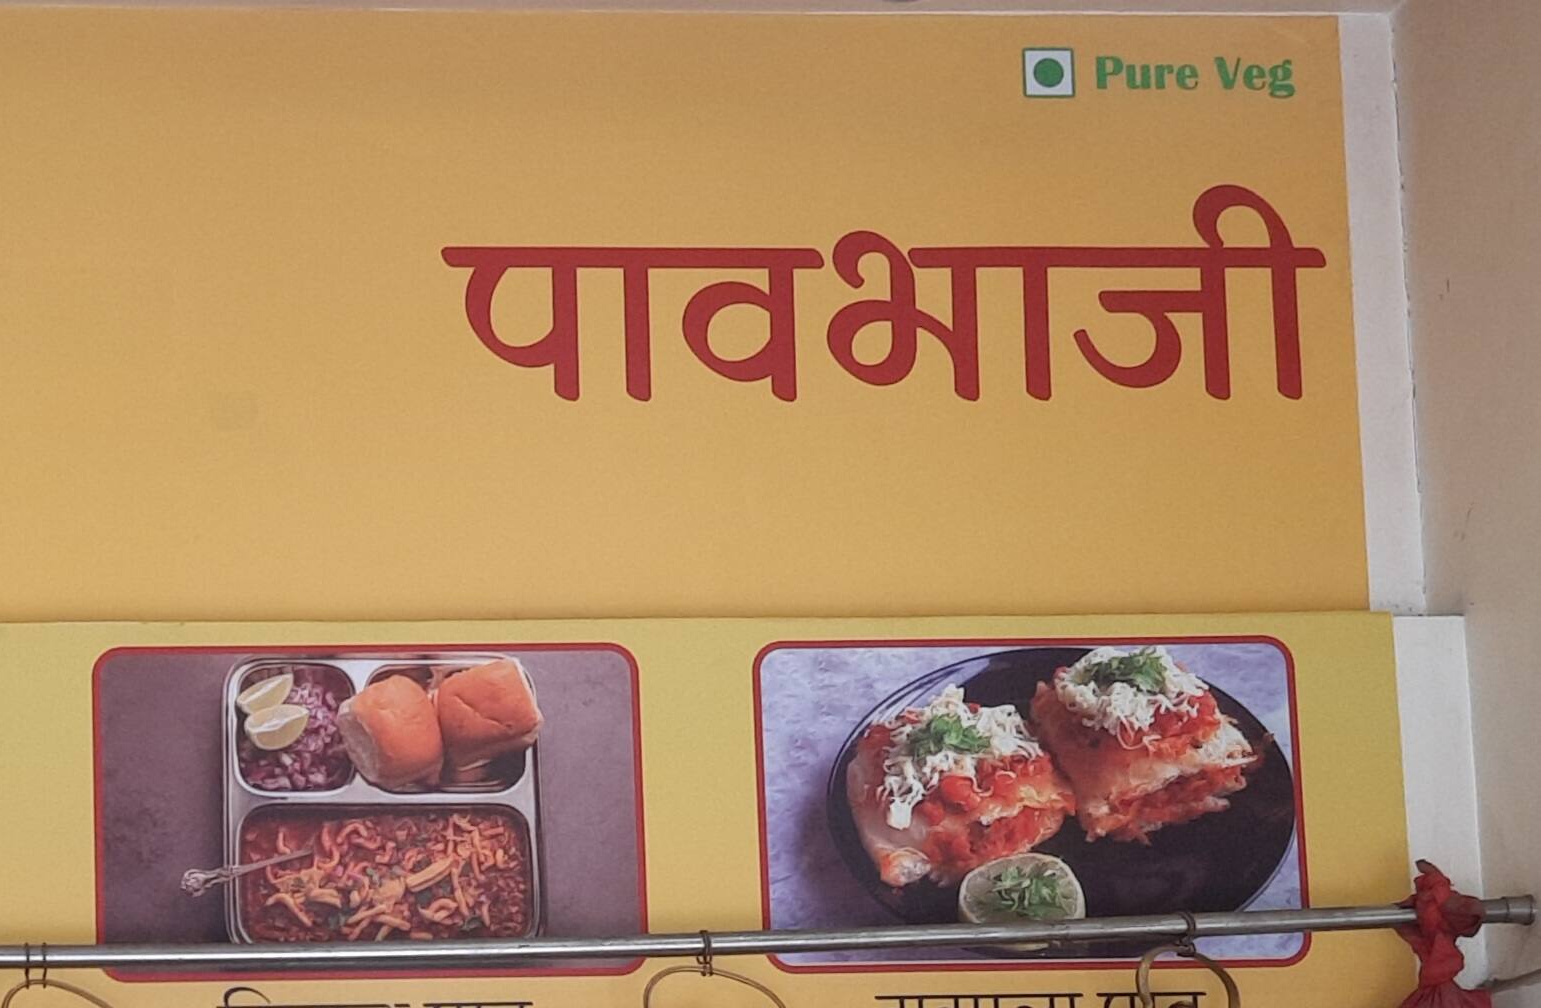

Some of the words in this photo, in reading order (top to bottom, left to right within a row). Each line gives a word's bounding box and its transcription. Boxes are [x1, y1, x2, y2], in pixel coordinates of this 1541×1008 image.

[1096, 56, 1199, 90] Pure
[1214, 56, 1295, 98] Veg
[441, 183, 1327, 402] पावभाजी
